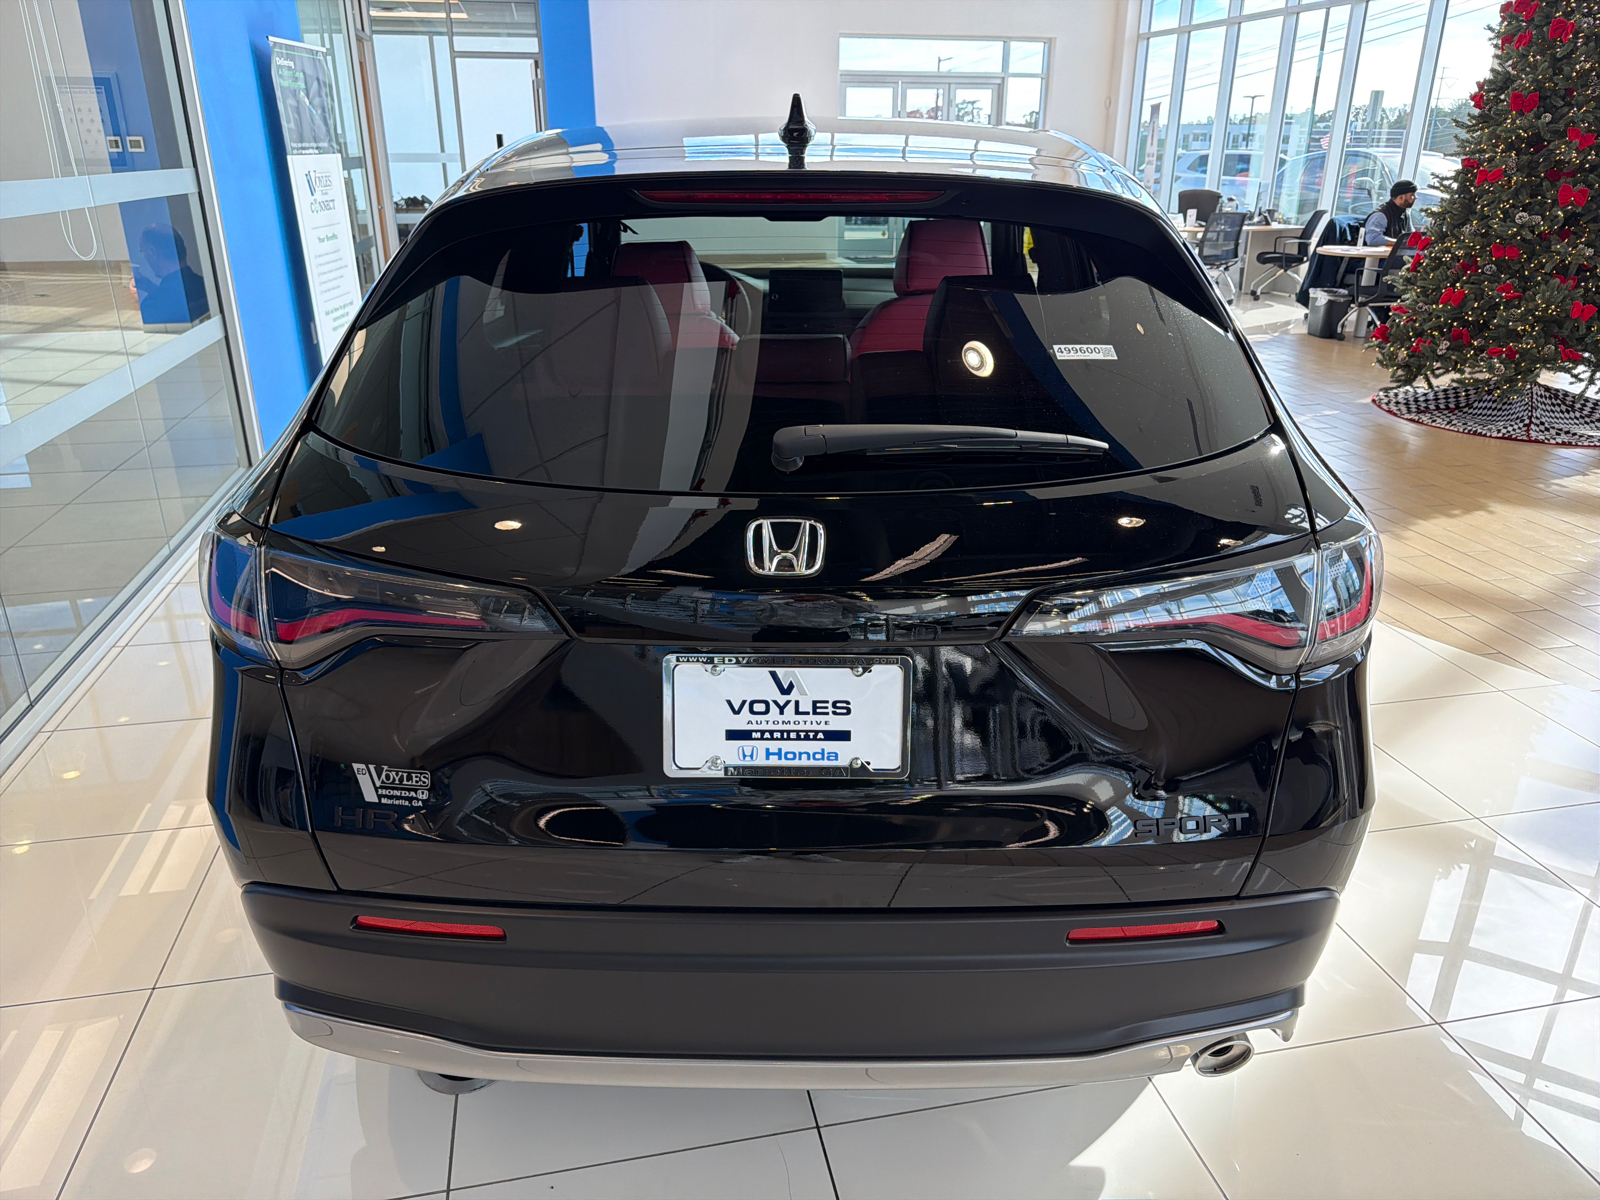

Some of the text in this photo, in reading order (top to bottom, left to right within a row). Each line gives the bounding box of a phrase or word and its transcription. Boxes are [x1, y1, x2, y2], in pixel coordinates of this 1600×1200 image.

[1056, 346, 1101, 355] 499600
[725, 699, 852, 716] VOYLES
[765, 747, 839, 761] Honda
[356, 767, 367, 776] ED
[368, 764, 429, 788] VOYLES
[377, 788, 418, 798] HONDA
[380, 797, 411, 807] Marietta,
[1134, 812, 1249, 838] SPORT
